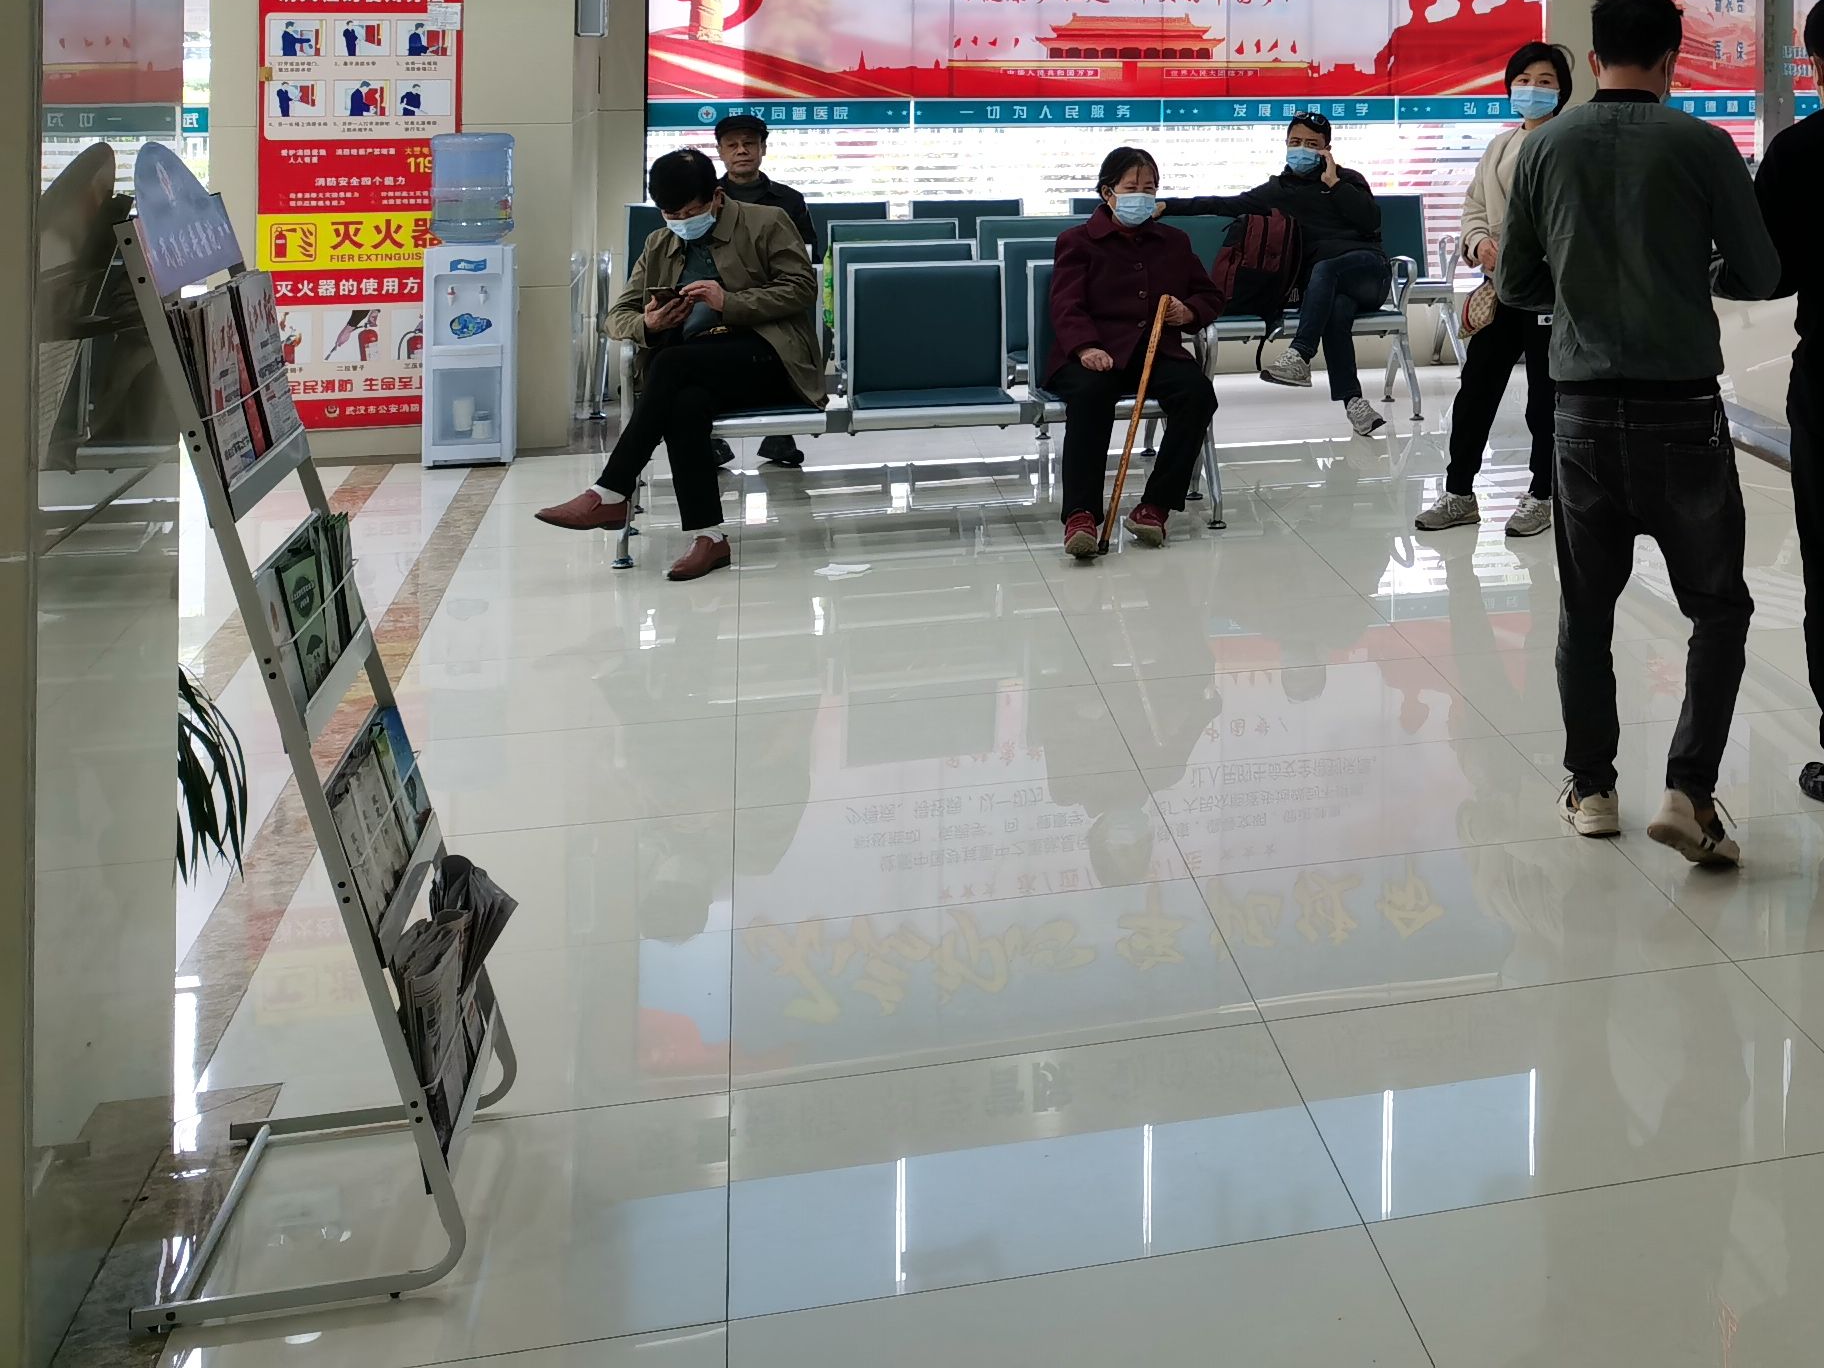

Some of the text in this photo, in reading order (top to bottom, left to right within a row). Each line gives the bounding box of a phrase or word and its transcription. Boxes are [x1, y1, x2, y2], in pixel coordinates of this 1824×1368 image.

[727, 105, 849, 121] 武汉同普医院
[959, 104, 1132, 120] 一切为人民服务
[1232, 102, 1370, 118] 发展祖国医学
[330, 218, 444, 250] 灭火器
[329, 253, 355, 263] FIER
[275, 276, 421, 298] 灭火器的使用方
